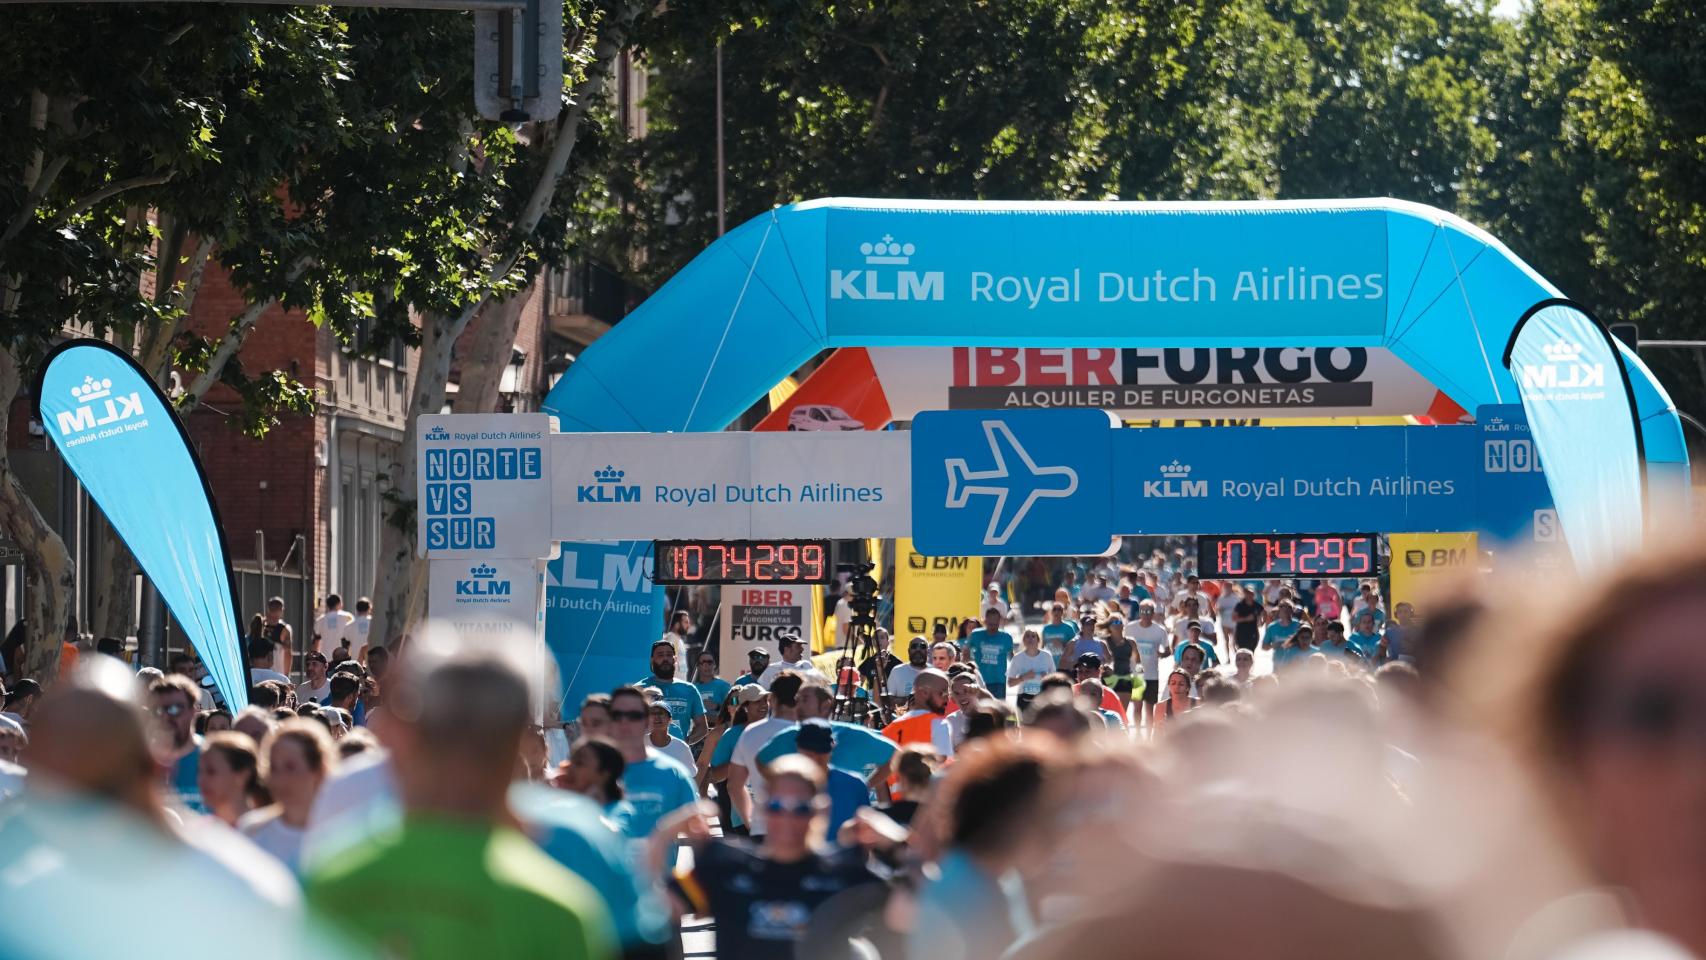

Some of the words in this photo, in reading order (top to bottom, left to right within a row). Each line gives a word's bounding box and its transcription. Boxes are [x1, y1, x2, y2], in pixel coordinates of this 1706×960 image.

[830, 269, 945, 300] KLM
[972, 268, 1081, 310] Royal
[1099, 267, 1217, 303] Dutch
[1232, 266, 1384, 302] Airlines
[952, 346, 1369, 388] IBERFURGO
[1004, 390, 1116, 409] ALQUILER
[1124, 389, 1154, 407] DE
[1162, 388, 1315, 406] FURGONETAS
[425, 433, 450, 441] KLM
[454, 432, 479, 442] Royal
[481, 431, 507, 440] Dutch
[509, 431, 542, 440] Airlines
[1484, 424, 1510, 432] KLM
[1514, 424, 1531, 433] Roy
[428, 450, 538, 478] NORTE
[428, 486, 469, 512] VS
[577, 485, 641, 503] KLM
[655, 483, 716, 507] Royal
[726, 483, 791, 503] Dutch
[800, 482, 883, 503] Airlines
[1143, 480, 1208, 498] KLM
[1222, 478, 1285, 502] Royal
[1294, 477, 1361, 497] Dutch
[1369, 476, 1455, 496] Airlines
[430, 520, 493, 547] SUR
[933, 555, 969, 570] BM
[456, 580, 511, 595] KLM
[741, 589, 793, 607] IBER
[560, 596, 602, 611] Dutch
[606, 600, 651, 615] Airlines
